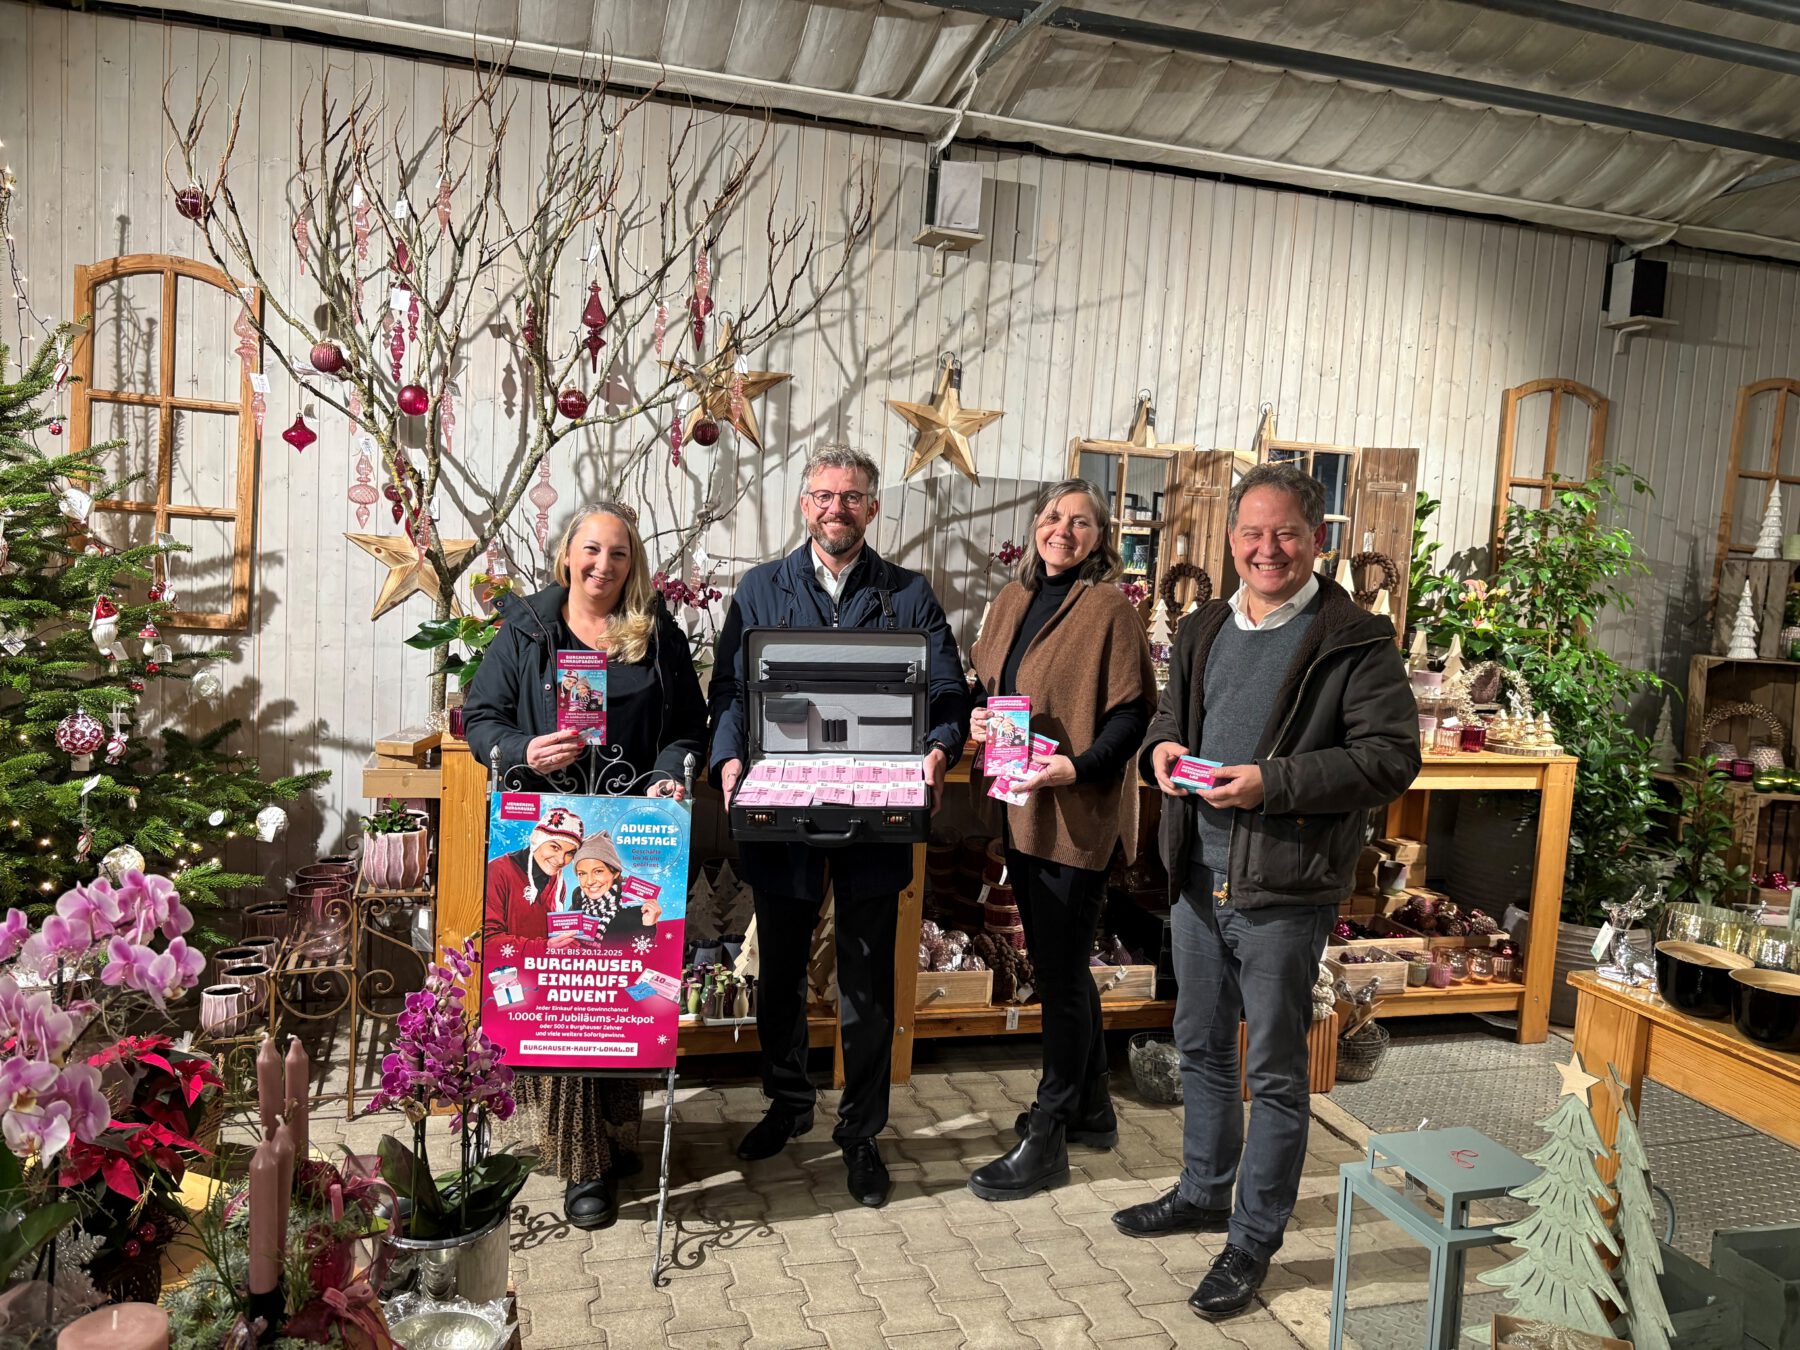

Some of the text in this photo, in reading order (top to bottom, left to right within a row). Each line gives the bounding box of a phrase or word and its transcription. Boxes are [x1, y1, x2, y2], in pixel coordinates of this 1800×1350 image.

[620, 824, 679, 834] ADVENTS-
[616, 836, 678, 846] SAMSTAGE
[524, 957, 643, 972] BURGHAUSER
[538, 973, 628, 988] EINKAUFS
[547, 989, 618, 1003] ADVENT
[508, 1012, 654, 1025] 1.000€ im Jubiläums-Jackpot
[523, 1044, 635, 1053] BURGHAUSEN-KAUFT-LOKAL.DE
